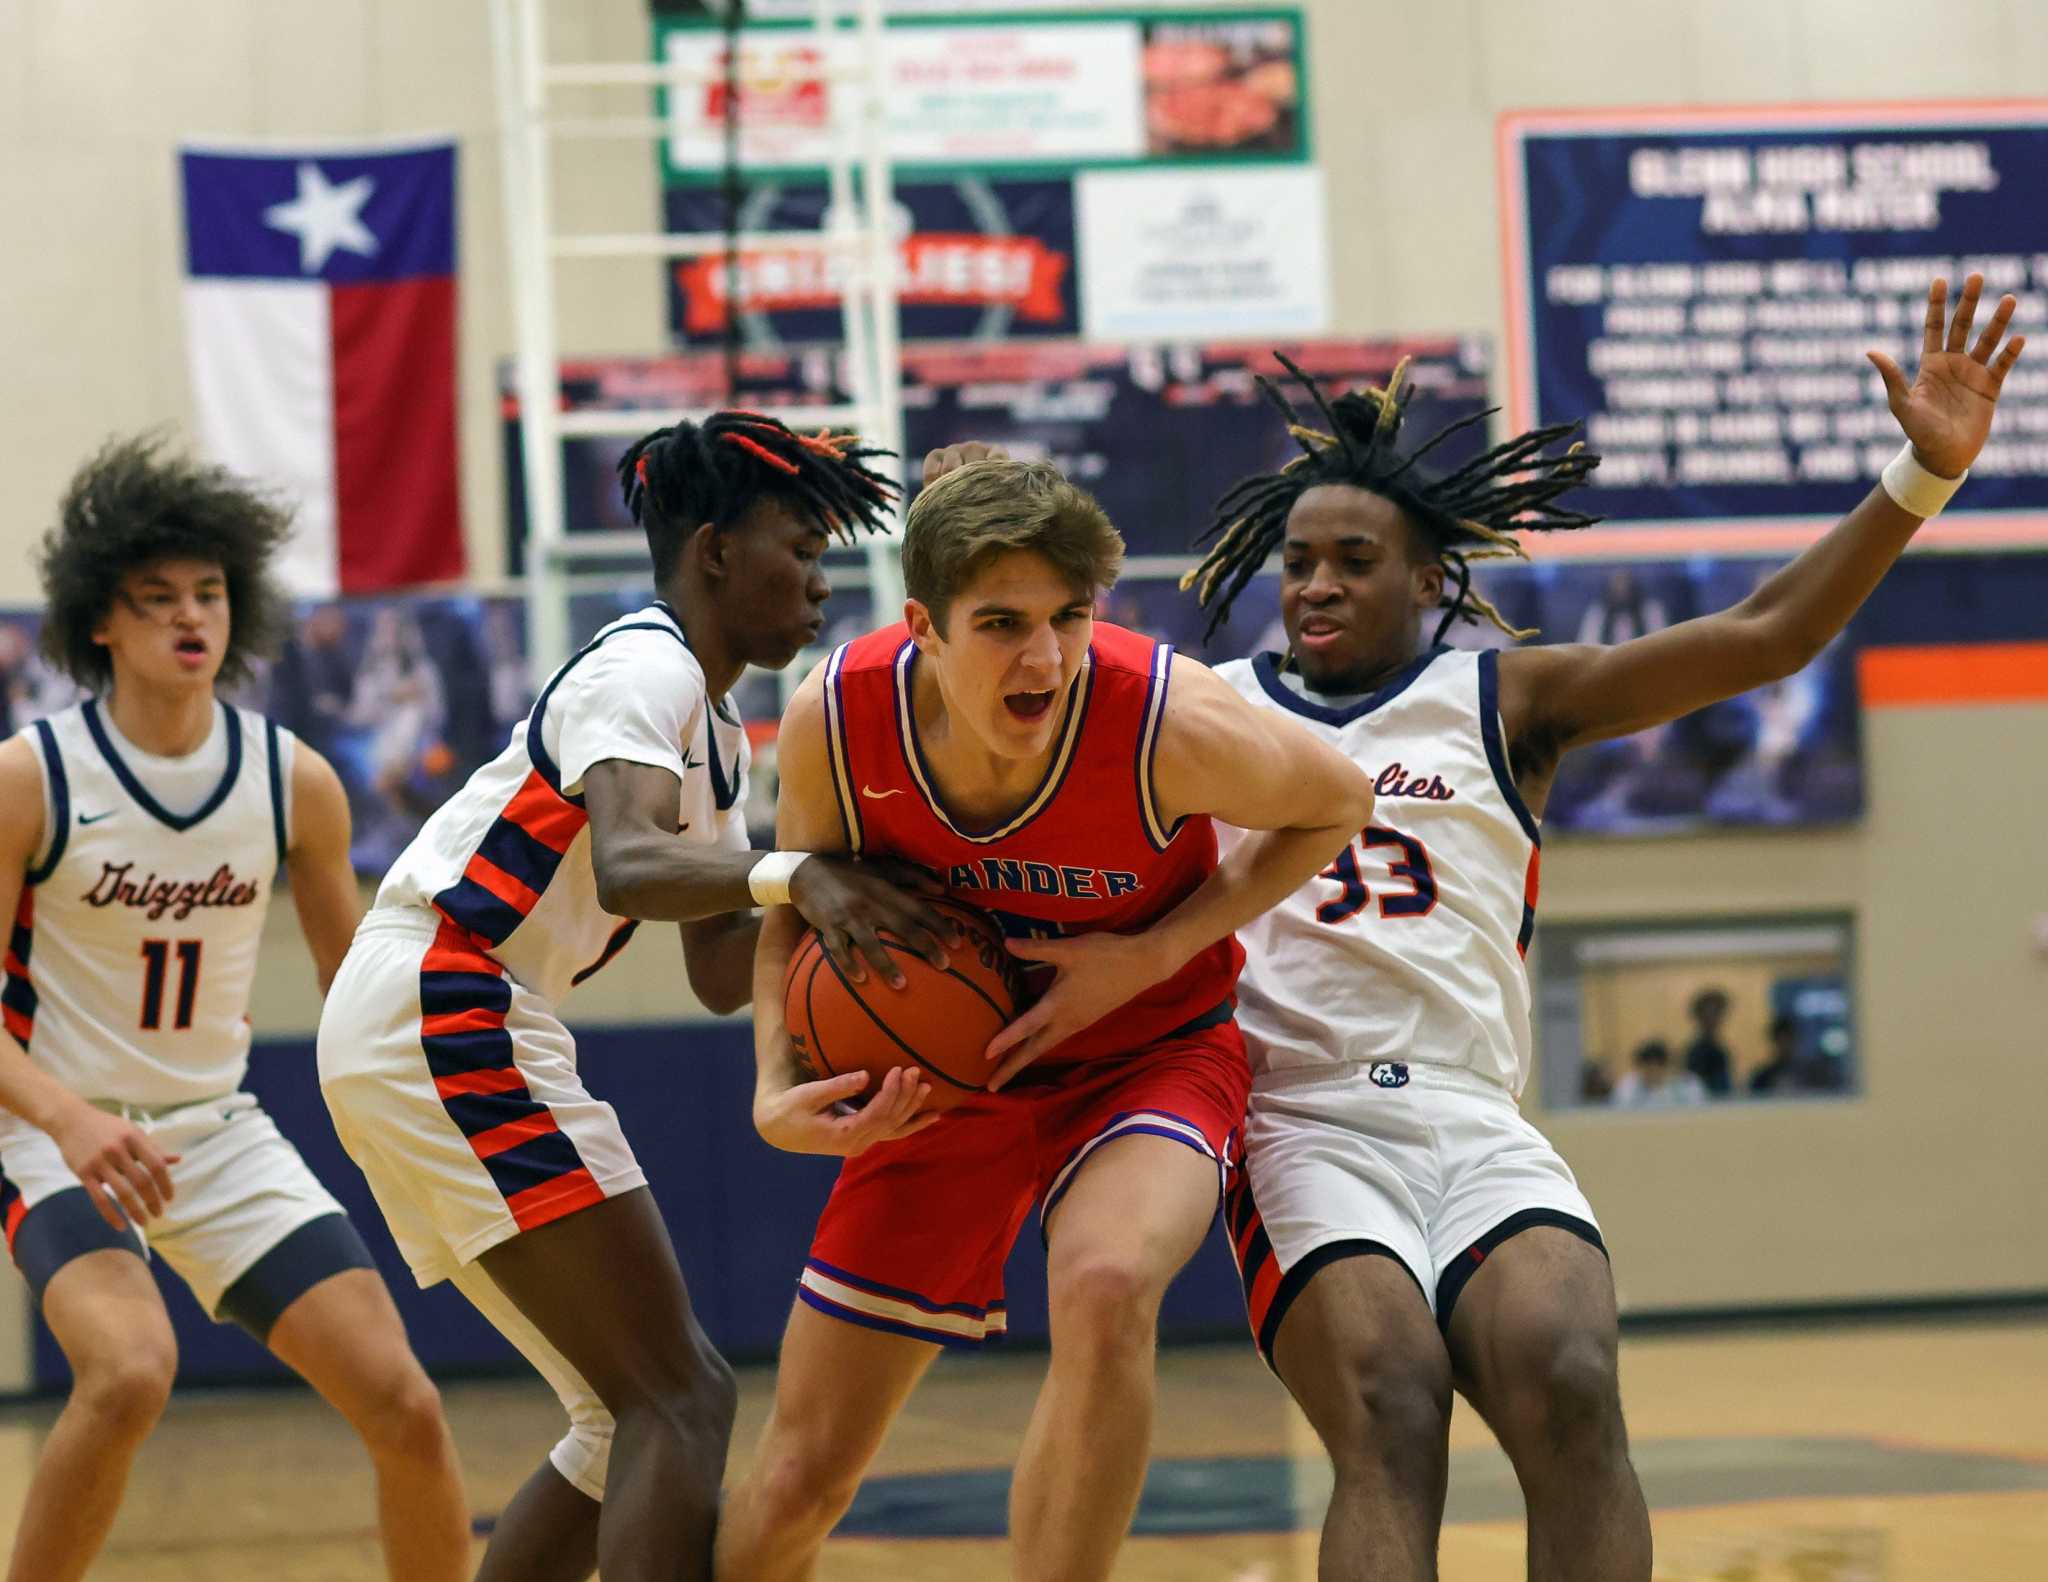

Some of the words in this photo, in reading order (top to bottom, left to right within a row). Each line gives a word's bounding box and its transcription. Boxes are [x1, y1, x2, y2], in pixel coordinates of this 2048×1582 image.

[81, 860, 258, 921] Grizzlies
[948, 856, 1140, 900] ANDER
[1315, 826, 1439, 925] 33
[138, 938, 203, 1032] 11
